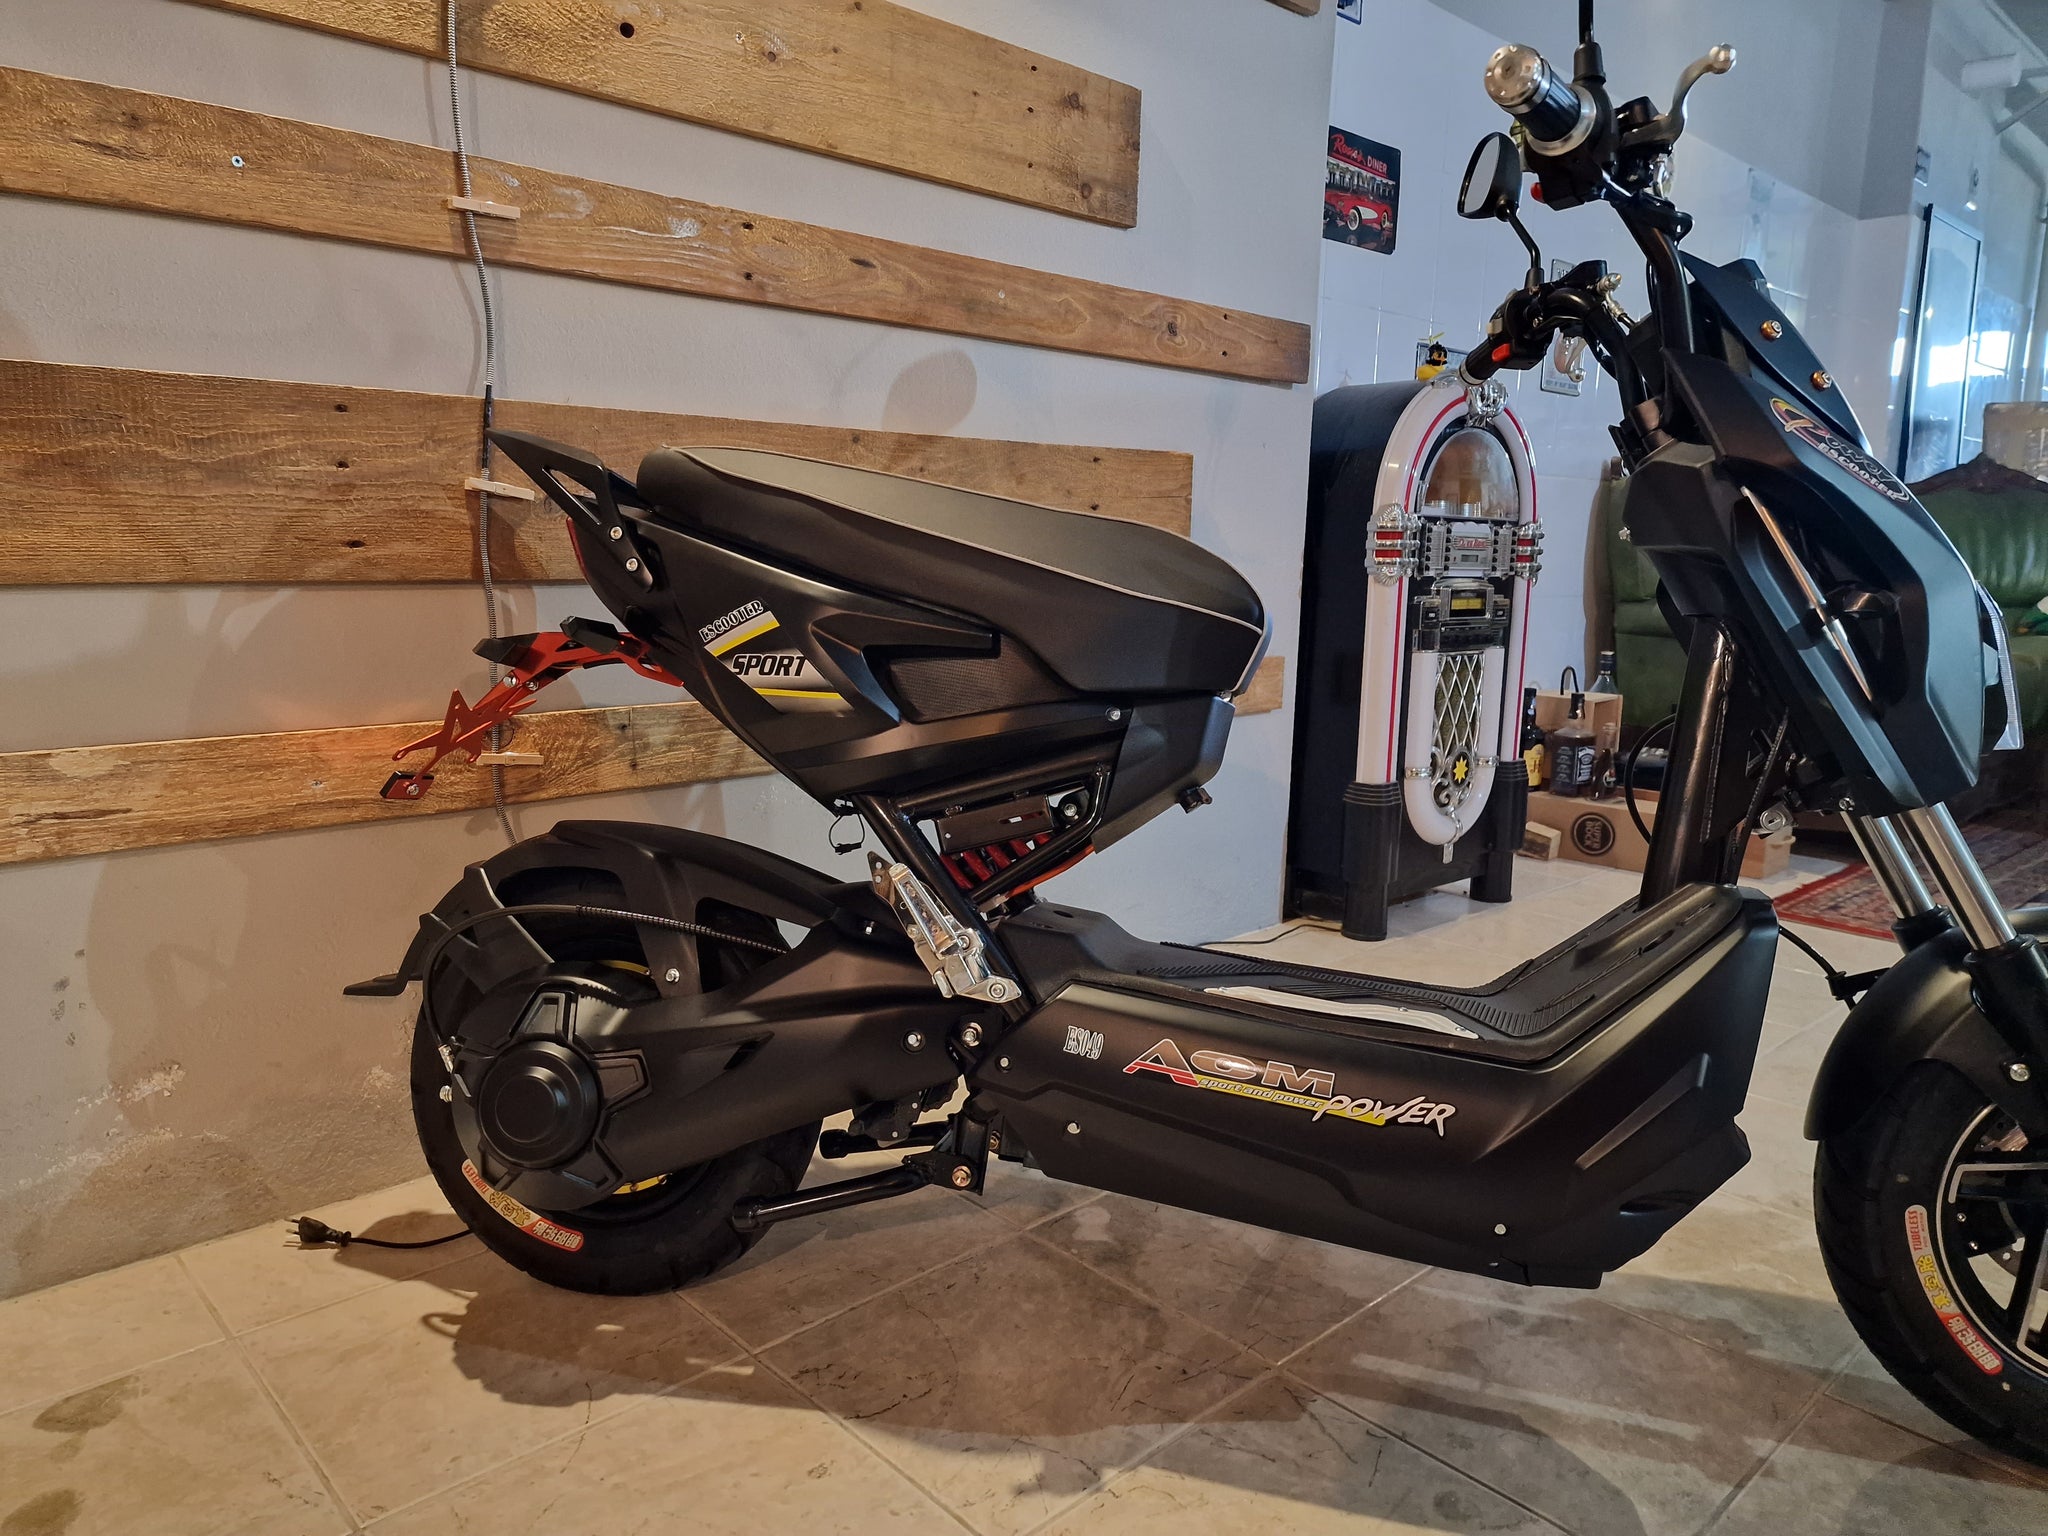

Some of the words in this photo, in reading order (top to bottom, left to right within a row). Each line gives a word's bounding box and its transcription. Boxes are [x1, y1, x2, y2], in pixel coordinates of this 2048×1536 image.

[1367, 155, 1388, 175] DINER
[1817, 442, 1901, 500] ESCOOTER
[699, 600, 763, 642] ESCOOTER
[732, 653, 807, 677] SPORT
[1200, 1078, 1243, 1092] sport
[1243, 1086, 1274, 1099] and
[1272, 1093, 1324, 1111] power
[1312, 1095, 1456, 1137] POWER
[1907, 1210, 1923, 1252] TUBELESS
[1916, 1254, 1951, 1309] 真空胎
